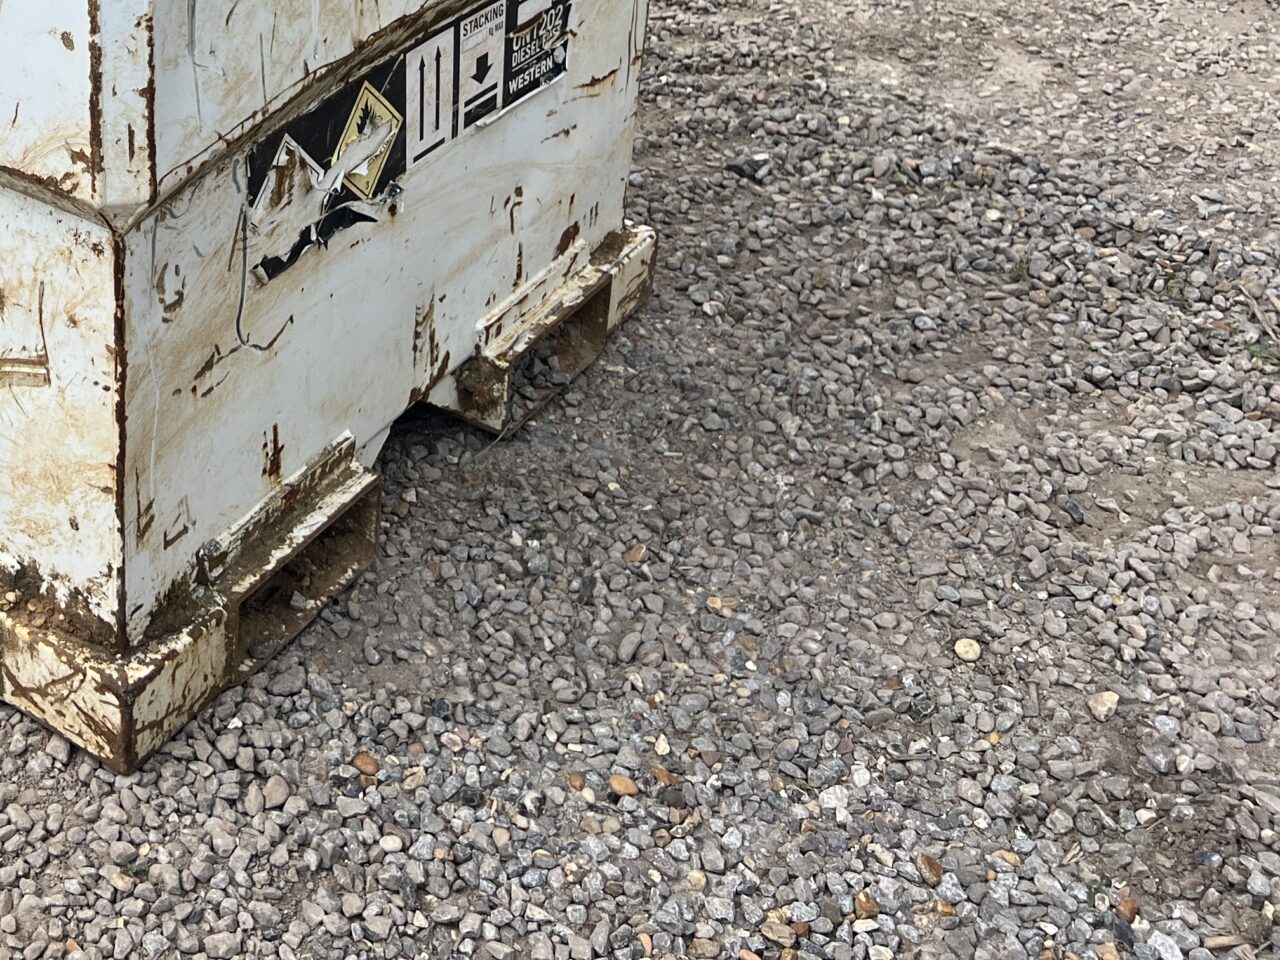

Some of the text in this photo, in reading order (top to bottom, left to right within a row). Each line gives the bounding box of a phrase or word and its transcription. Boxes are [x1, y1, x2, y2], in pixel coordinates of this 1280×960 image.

[462, 3, 504, 37] STACKING
[511, 39, 541, 67] DIESEL
[508, 54, 554, 94] WESTERN
